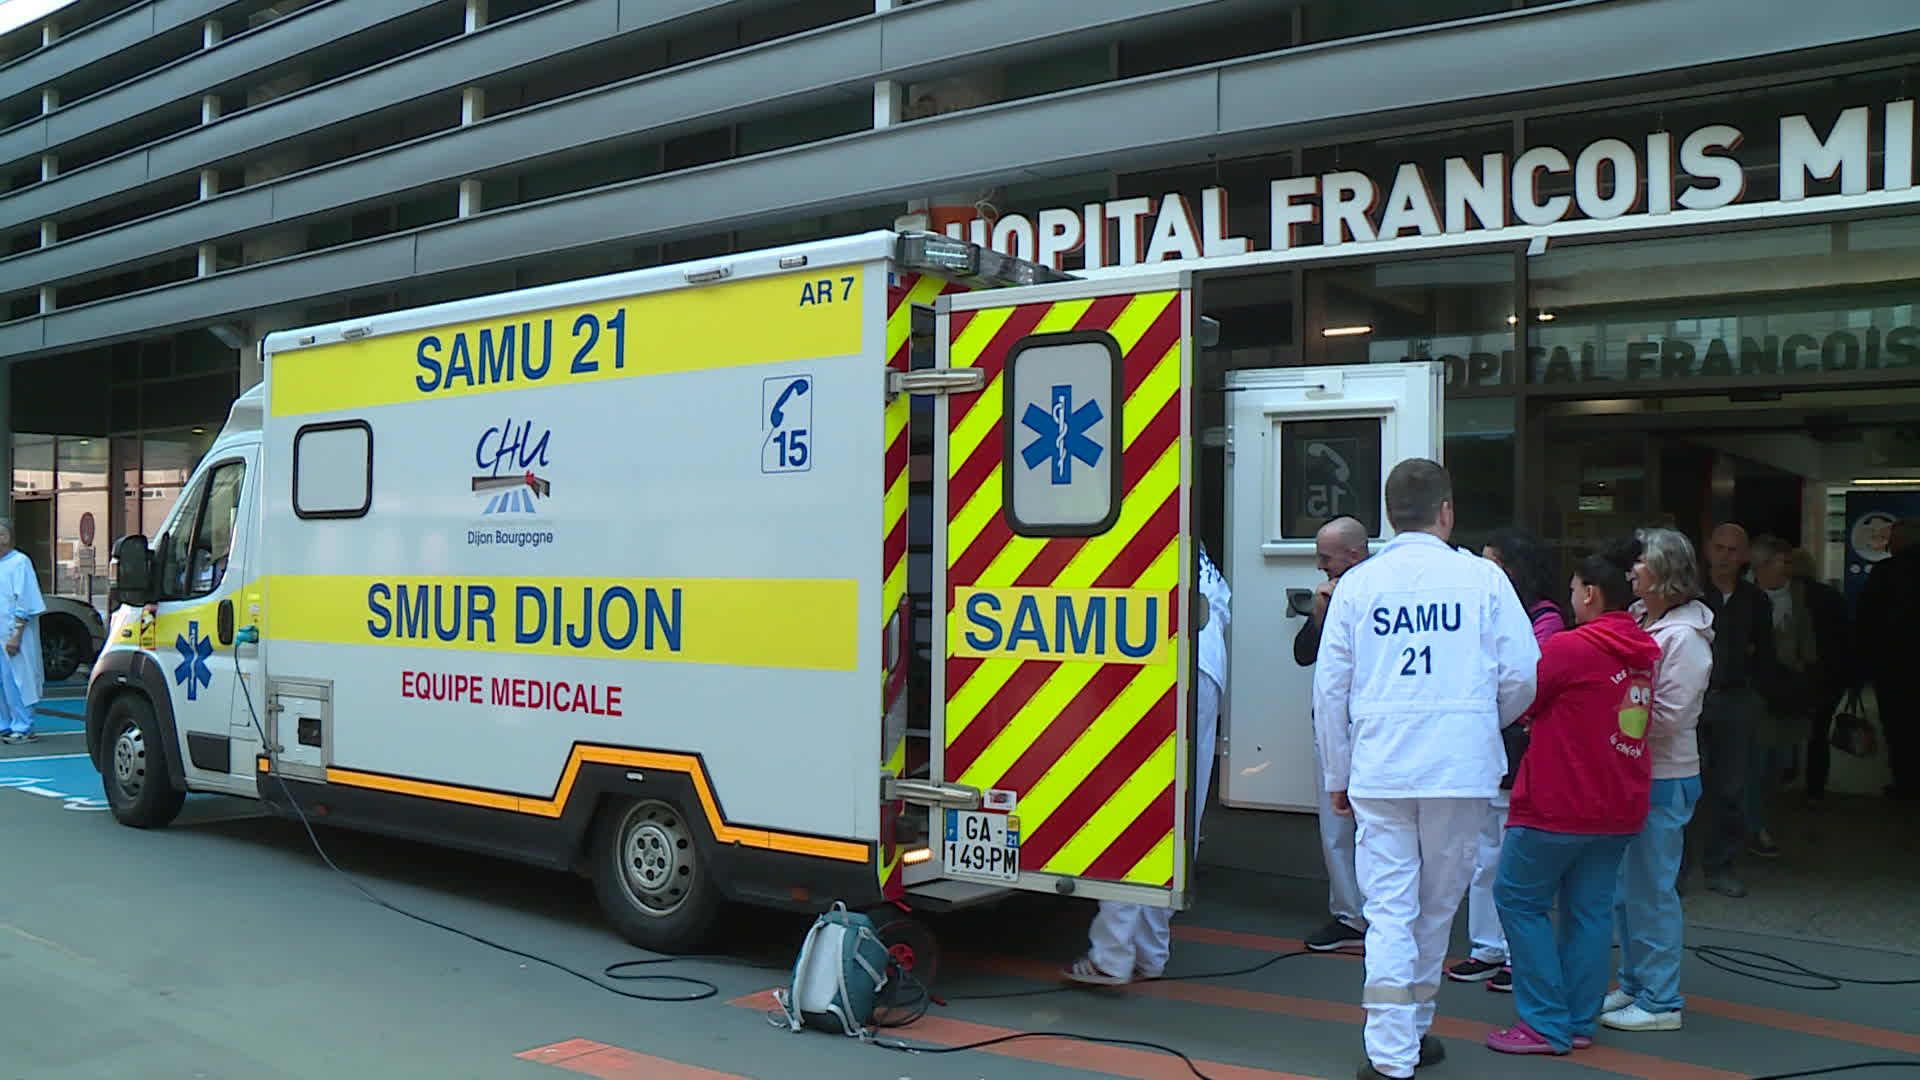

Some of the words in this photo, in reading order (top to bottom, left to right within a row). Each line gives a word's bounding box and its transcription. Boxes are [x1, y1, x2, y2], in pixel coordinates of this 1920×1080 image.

[800, 280, 832, 306] AR
[841, 275, 855, 301] 7
[416, 319, 553, 392] SAMU
[571, 308, 626, 374] 21
[476, 417, 551, 480] CHU
[773, 429, 808, 467] 15
[467, 530, 493, 546] Dijon
[495, 530, 554, 547] Bourgogne
[366, 582, 496, 645] SMUR
[515, 586, 683, 652] DIJON
[965, 592, 1158, 658] SAMU
[1373, 602, 1461, 636] SAMU
[1400, 645, 1432, 676] 21
[402, 671, 483, 704] EQUIPE
[491, 677, 623, 717] MEDICALE
[950, 843, 1016, 874] 149-PM
